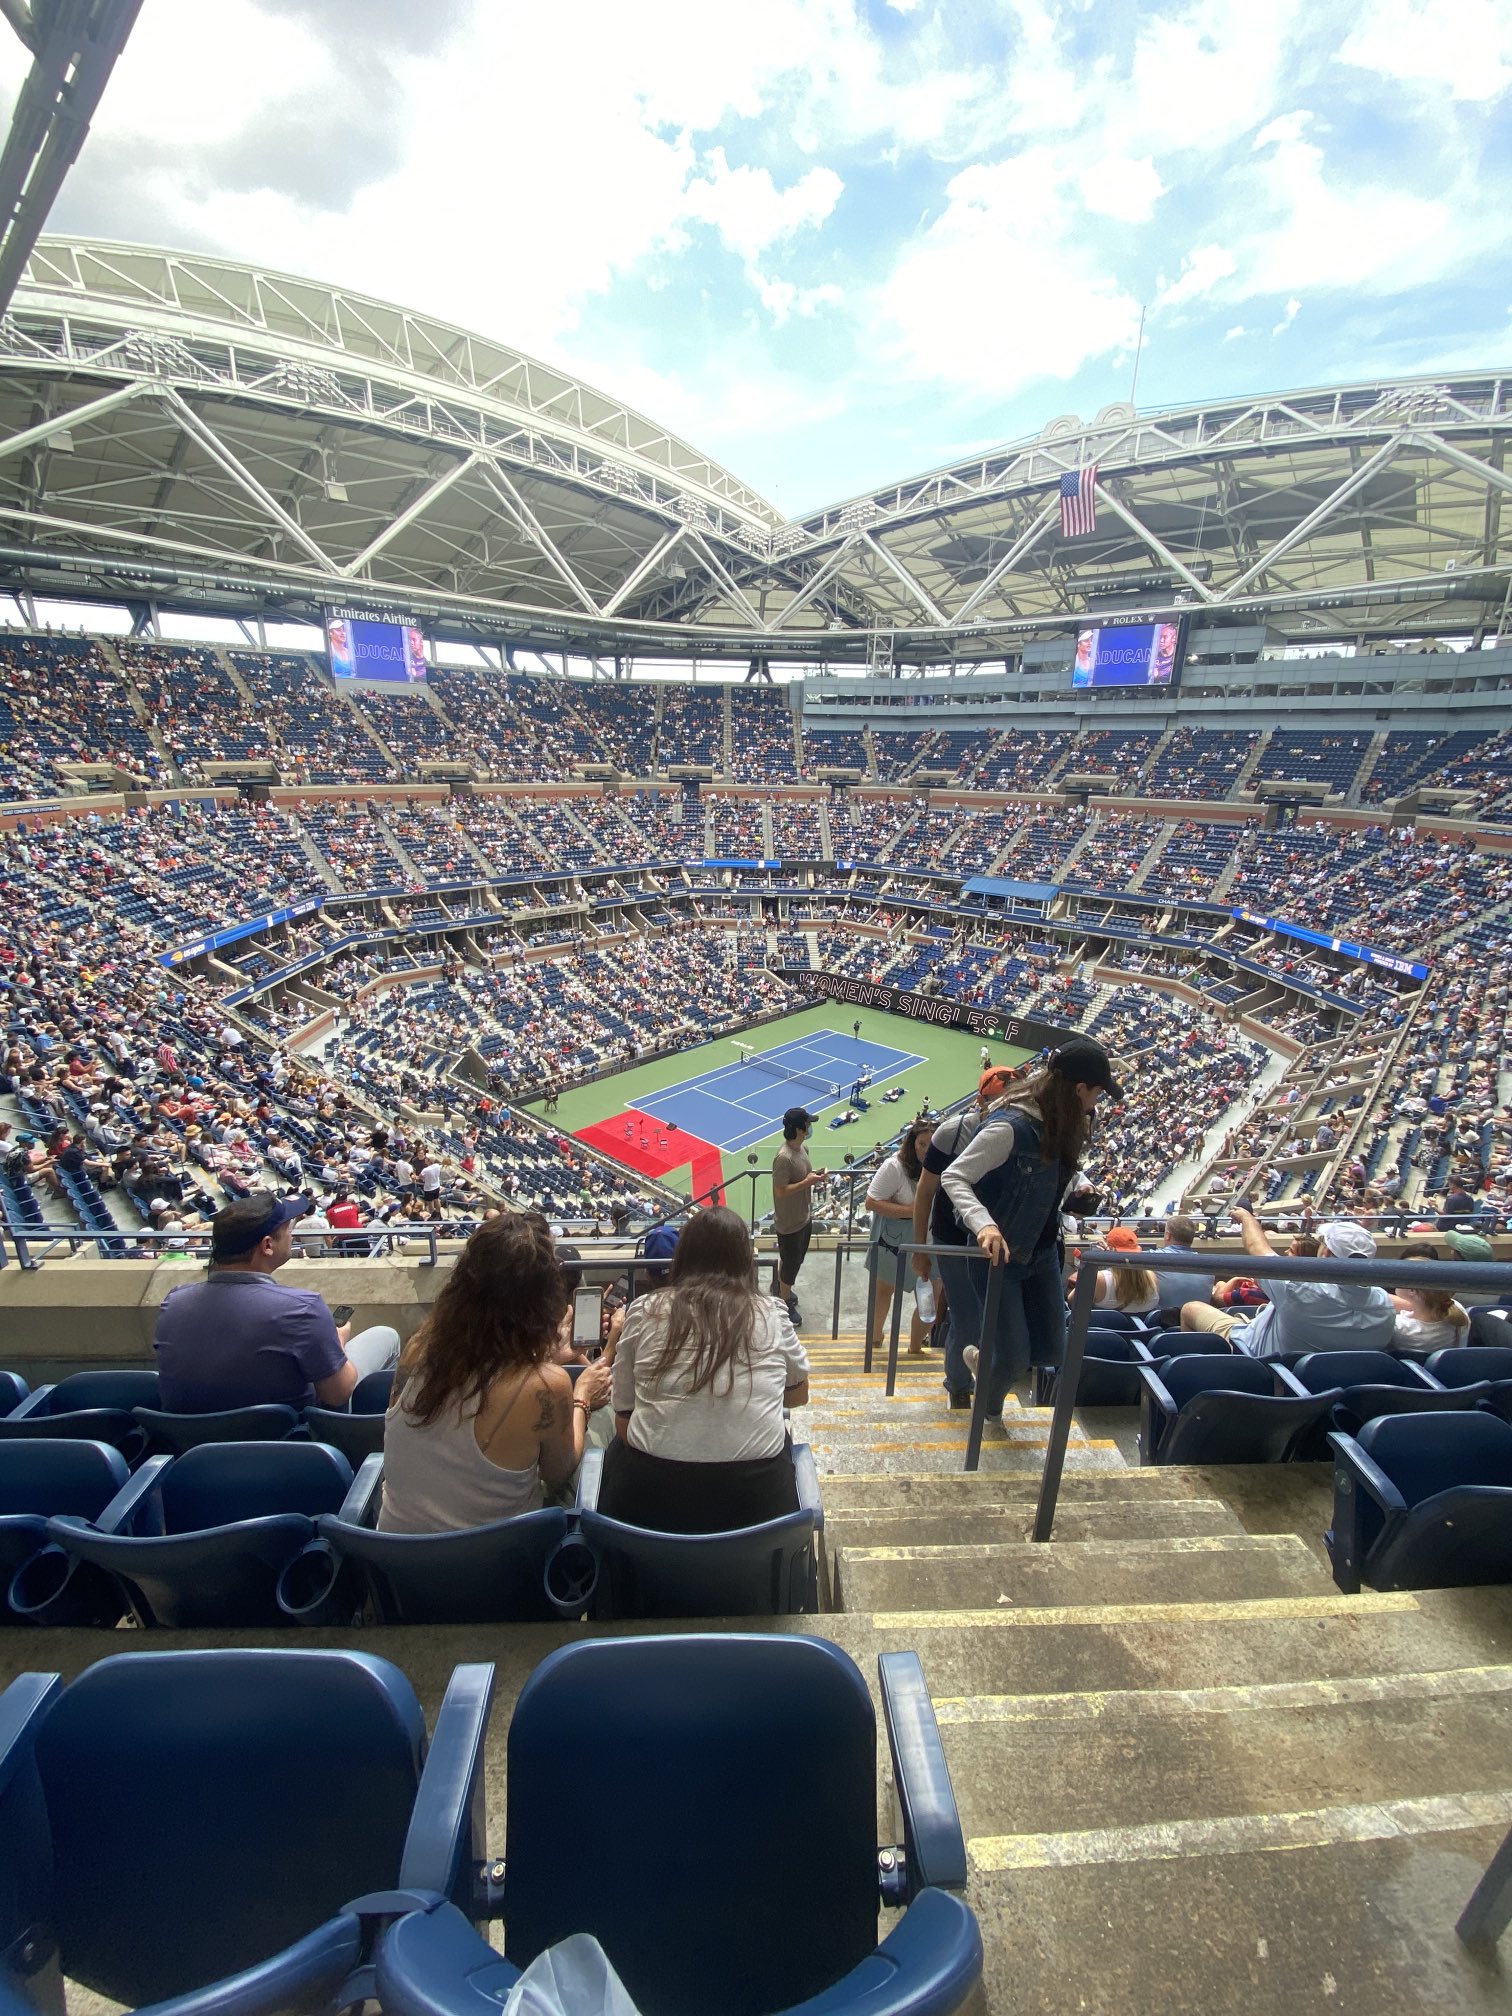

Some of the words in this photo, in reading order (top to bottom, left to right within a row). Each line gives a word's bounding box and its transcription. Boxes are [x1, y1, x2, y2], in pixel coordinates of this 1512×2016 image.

[332, 606, 380, 622] Emirates
[382, 613, 417, 627] Airline
[1113, 616, 1143, 625] ROLEX
[1158, 898, 1179, 906] CHASE
[1393, 959, 1415, 975] IBM
[1267, 970, 1284, 981] CHASE
